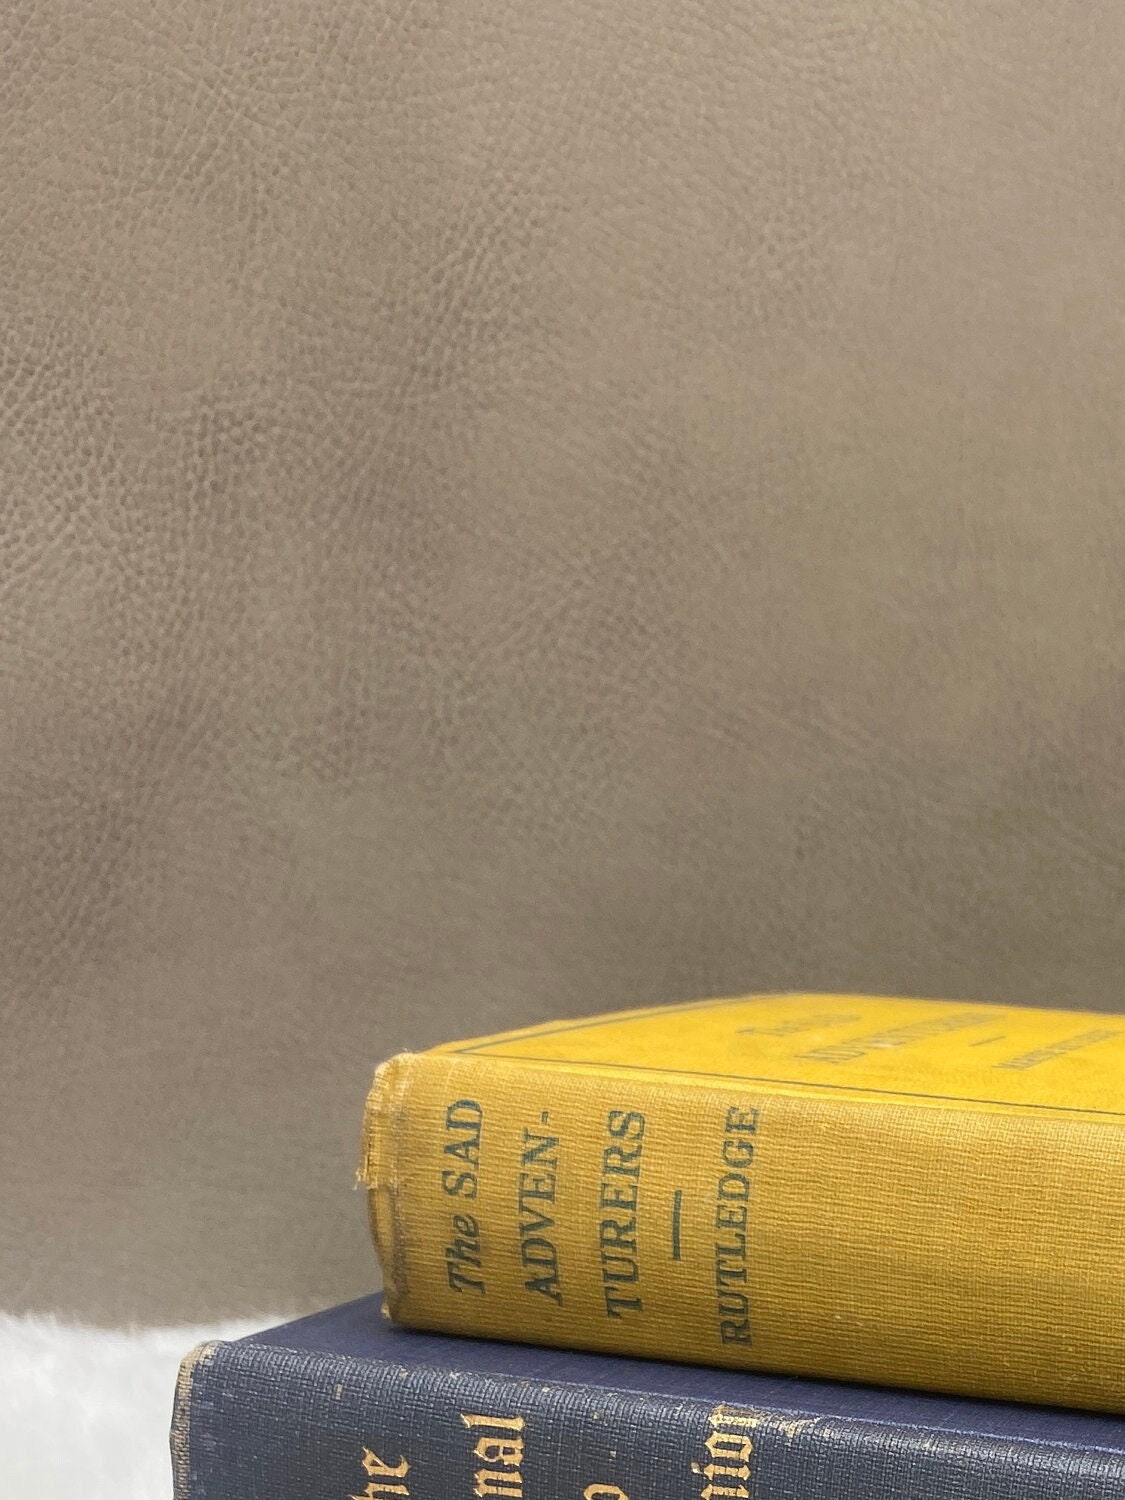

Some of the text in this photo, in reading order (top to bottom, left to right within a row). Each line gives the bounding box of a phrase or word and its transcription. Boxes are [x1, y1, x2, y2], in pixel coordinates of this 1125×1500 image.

[441, 1099, 485, 1294] The SAD
[518, 1110, 563, 1307] ADVEN-
[599, 1109, 646, 1320] TURERS
[714, 1105, 759, 1346] RUTLEDGE
